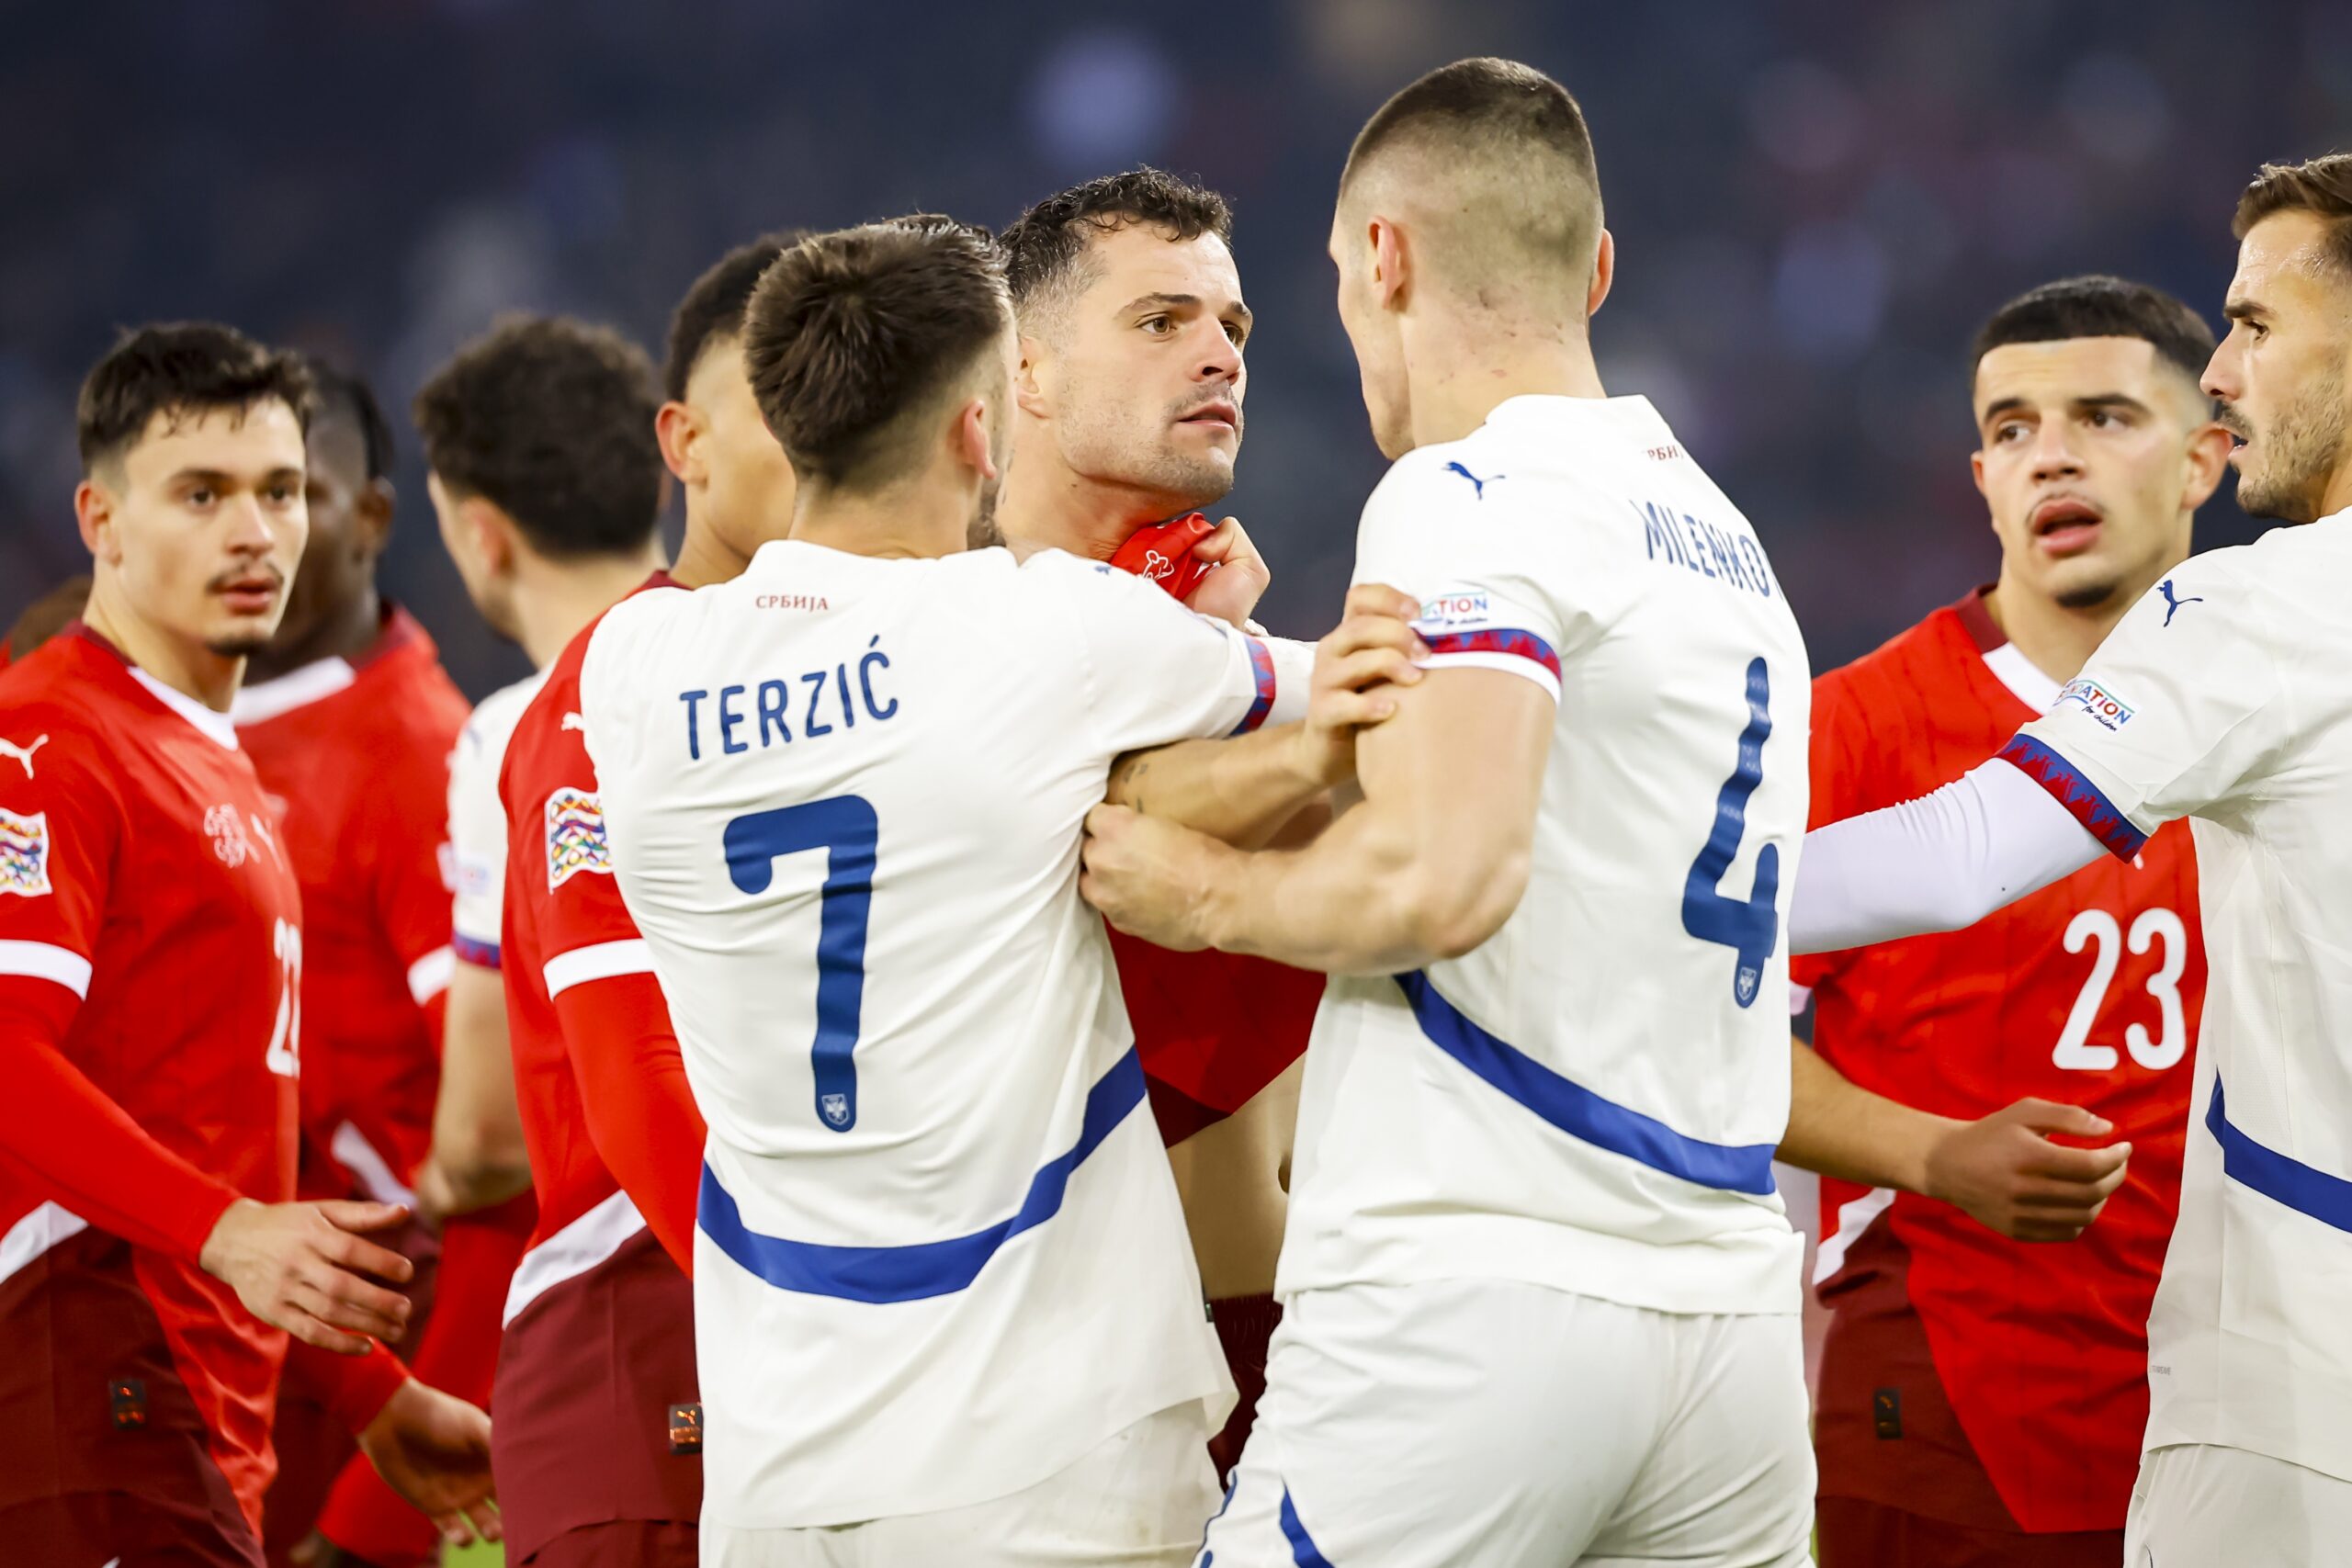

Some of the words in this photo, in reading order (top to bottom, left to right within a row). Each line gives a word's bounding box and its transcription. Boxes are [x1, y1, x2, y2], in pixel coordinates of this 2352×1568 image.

[756, 595, 829, 612] СРБИЈА
[1628, 500, 1784, 602] MILENKO
[680, 635, 898, 760] TERZIĆ
[1682, 657, 1779, 1009] 4
[723, 795, 878, 1133] 7
[2052, 908, 2187, 1070] 23
